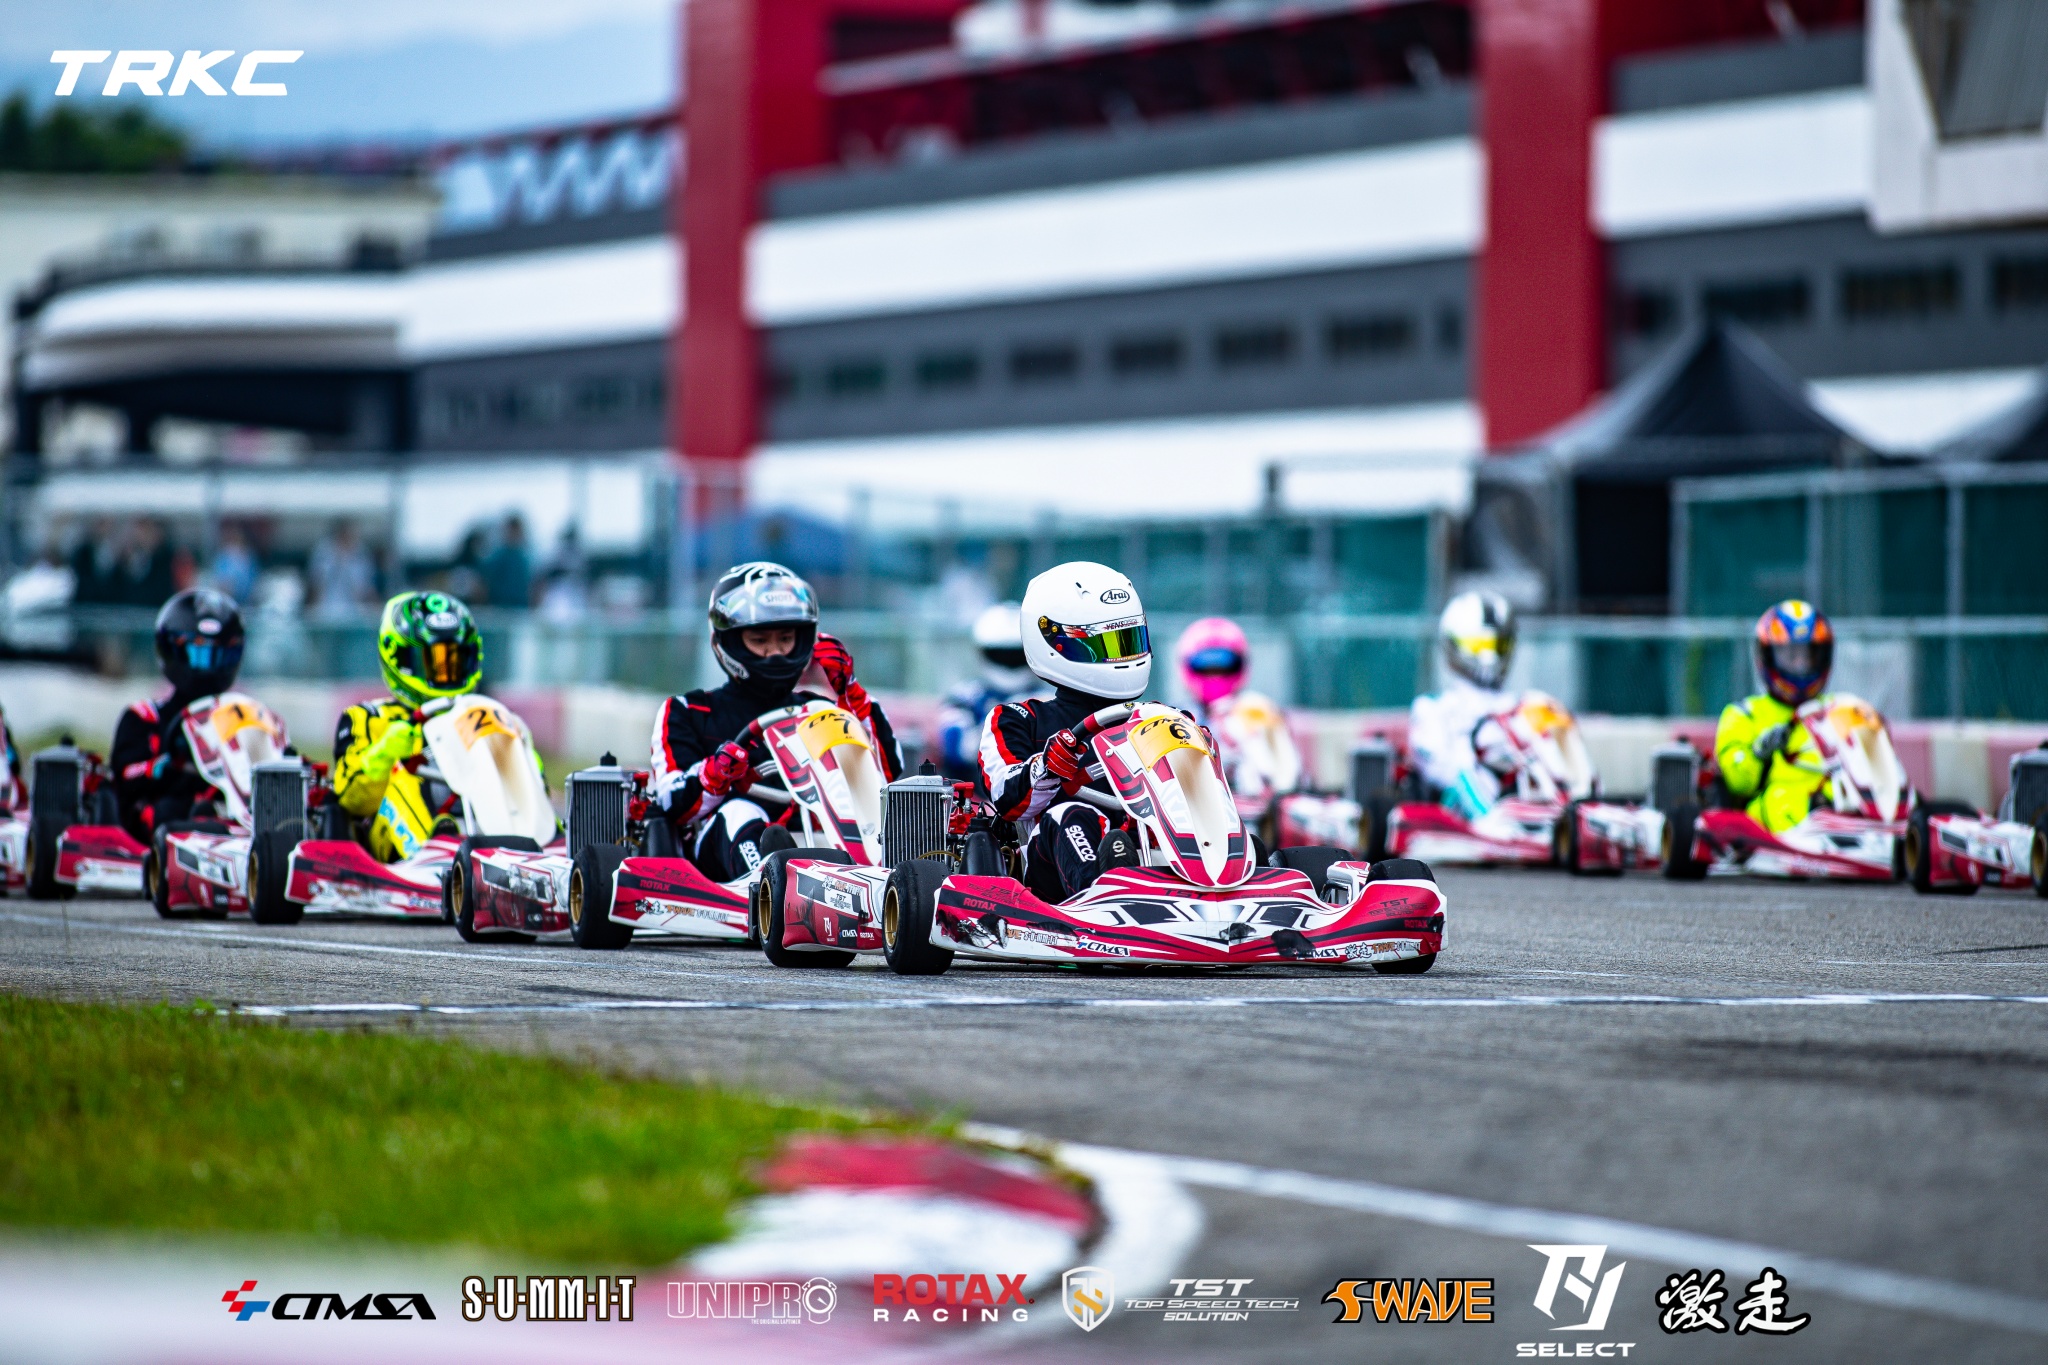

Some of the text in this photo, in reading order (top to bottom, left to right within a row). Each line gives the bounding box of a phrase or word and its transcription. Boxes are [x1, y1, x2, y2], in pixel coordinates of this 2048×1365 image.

[1103, 590, 1127, 602] Arai
[834, 718, 850, 734] 7
[1169, 723, 1191, 740] 6
[1065, 825, 1096, 862] sparco
[640, 879, 670, 892] ROTAX
[1163, 888, 1208, 900] TST
[963, 897, 997, 911] ROTAX
[1380, 897, 1408, 907] TST
[1404, 919, 1428, 929] ROTAX
[1087, 941, 1130, 956] CTMSA
